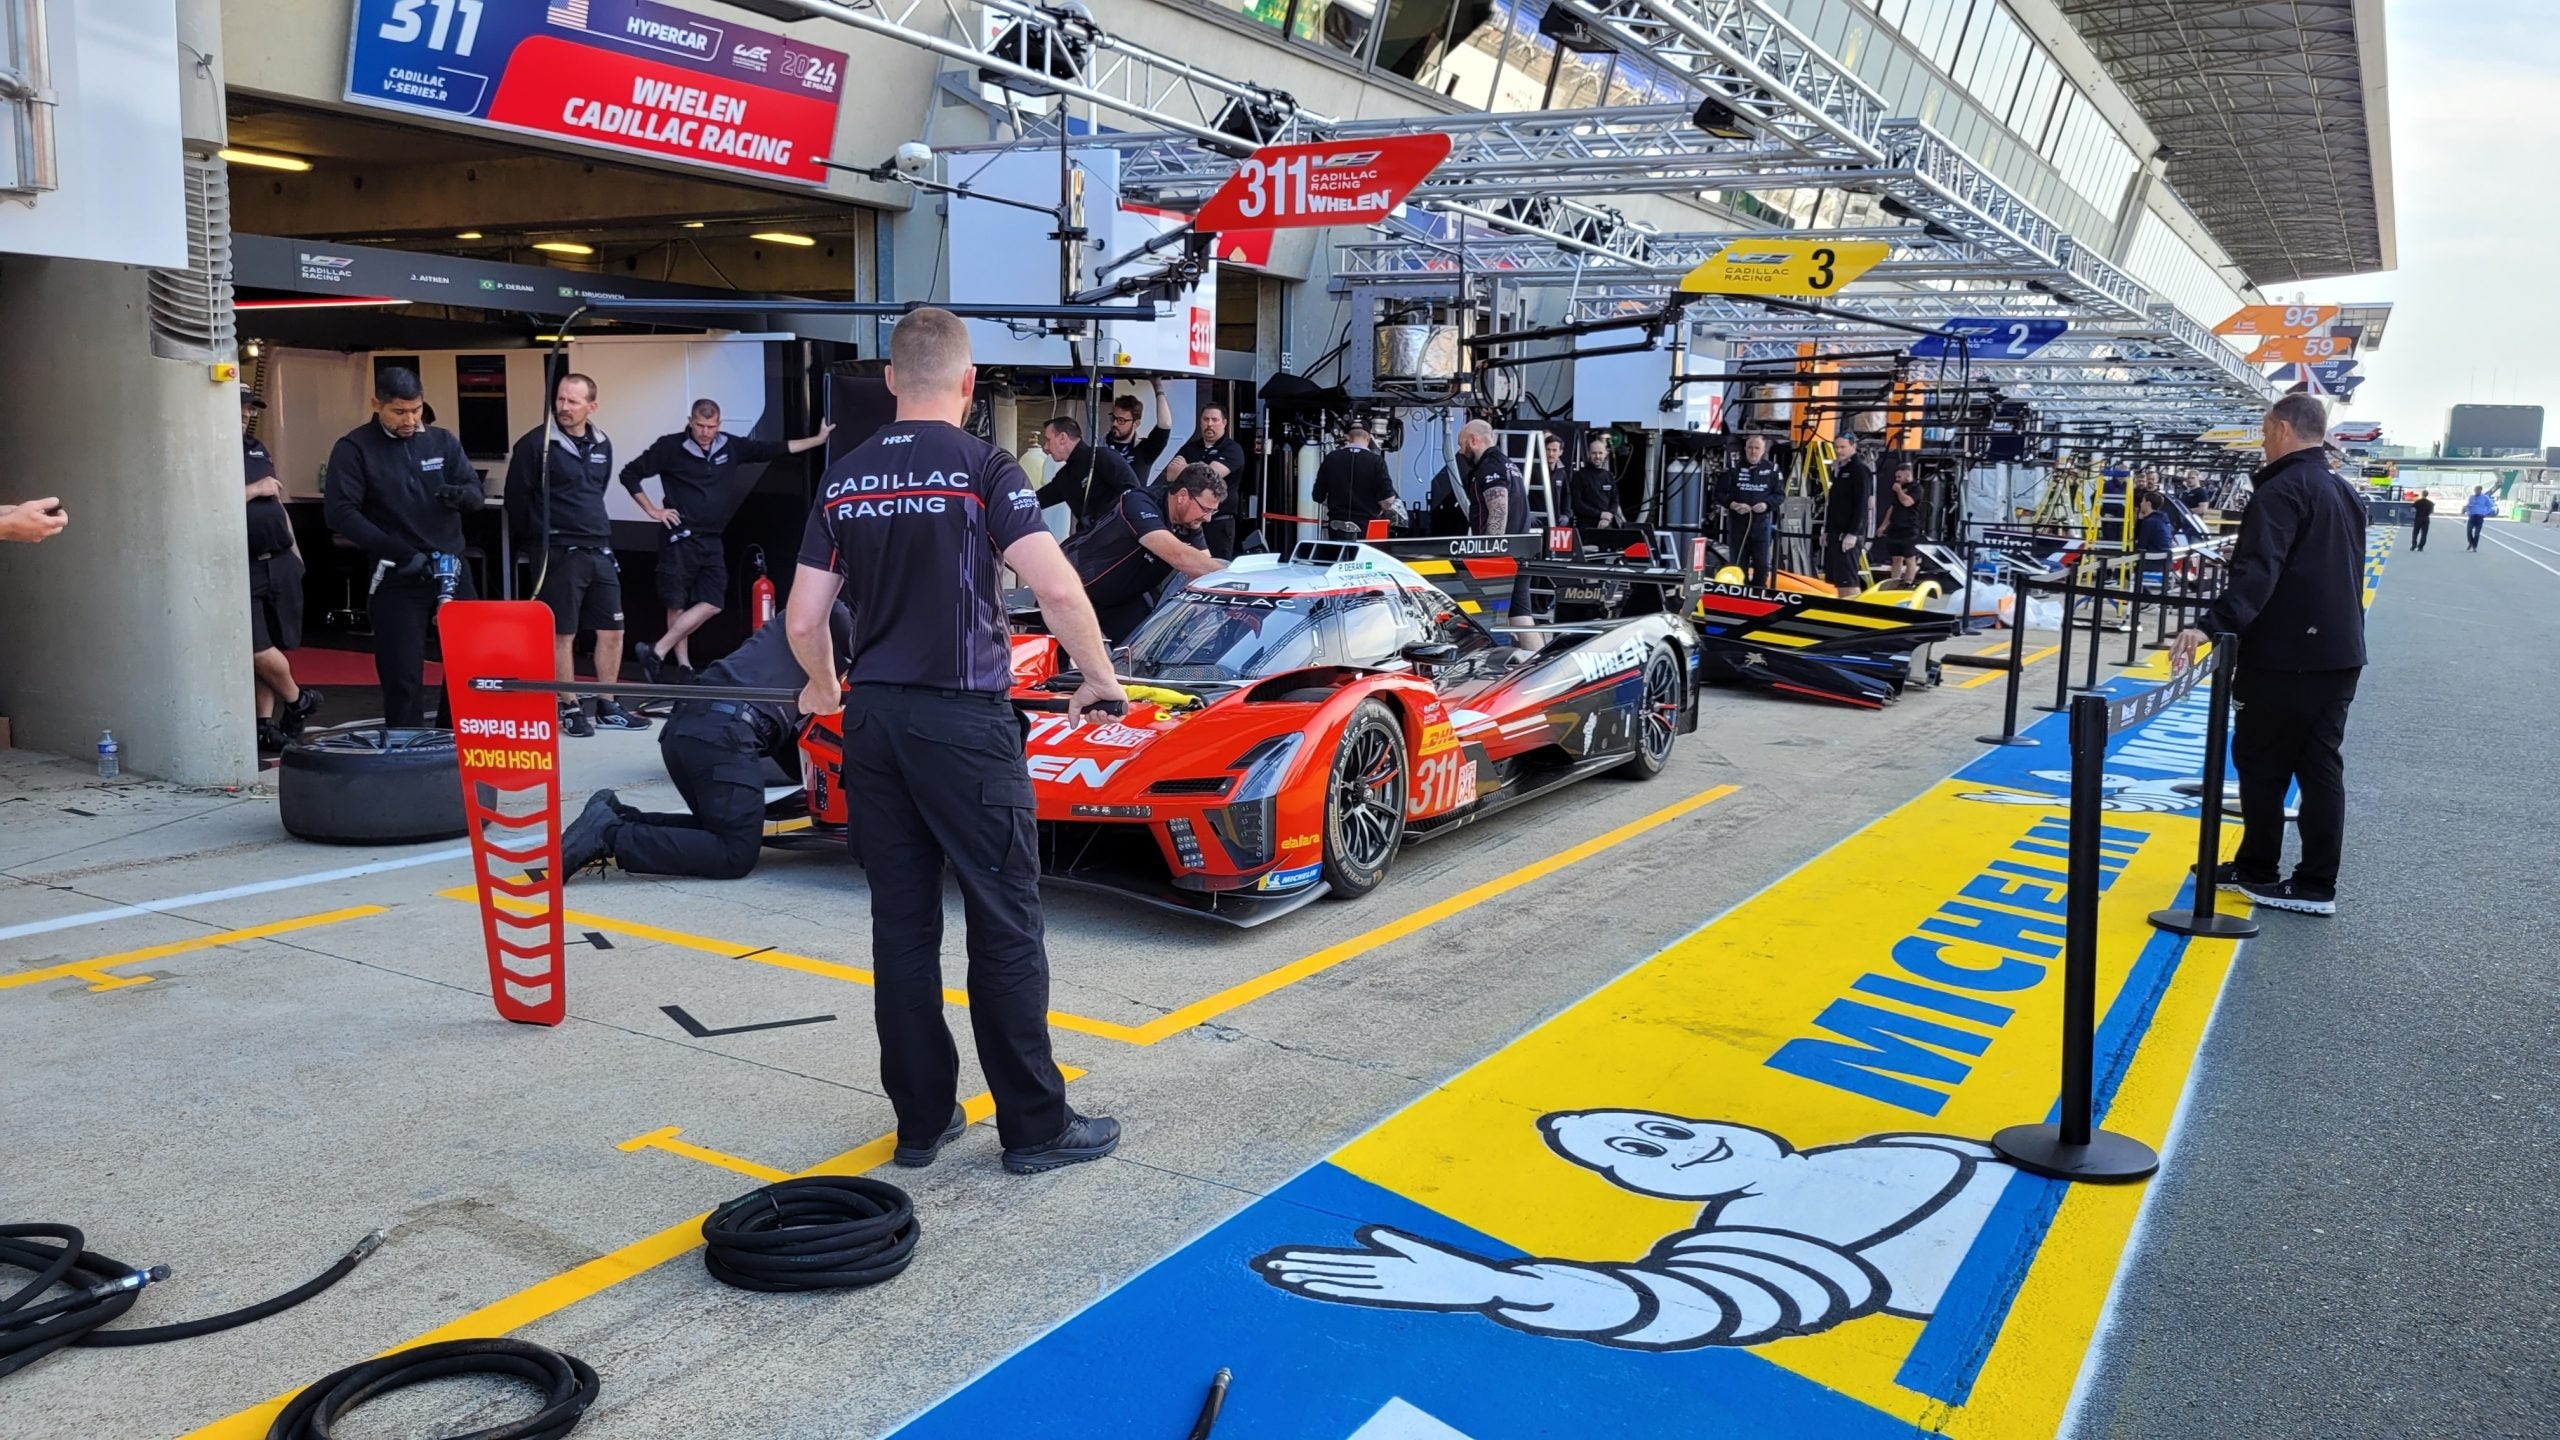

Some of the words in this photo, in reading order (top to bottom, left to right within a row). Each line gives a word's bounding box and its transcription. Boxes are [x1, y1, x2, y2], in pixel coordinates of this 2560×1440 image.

[378, 0, 484, 57] 311
[626, 16, 708, 51] HYPERCAR
[389, 67, 446, 88] CADILLAC
[383, 79, 448, 101] V-SERIES.R
[633, 76, 747, 125] WHELEN
[562, 97, 699, 148] CADILLAC
[698, 124, 793, 166] RACING
[1238, 155, 1307, 217] 311
[1311, 170, 1378, 183] CADILLAC
[1311, 180, 1361, 191] RACING
[1307, 189, 1390, 213] WHELEN
[302, 265, 353, 278] CADILLAC
[302, 272, 341, 282] RACING
[1724, 274, 1773, 282] RACING
[1725, 267, 1789, 276] CADILLAC
[1808, 248, 1836, 290] 3
[2283, 306, 2320, 328] 95
[1191, 321, 1209, 354] 311
[2006, 323, 2030, 354] 2
[2303, 338, 2334, 356] 59
[881, 434, 915, 446] HRX
[826, 470, 970, 499] CADILLAC
[838, 497, 946, 520] RACING
[1450, 538, 1509, 555] CADILLAC
[1549, 529, 1572, 549] HY
[1565, 588, 1601, 599] Mobil
[1701, 580, 1803, 605] CADILLAC
[1570, 629, 1649, 682] WHELEN
[460, 718, 517, 738] Brakes
[463, 748, 506, 768] BACK
[508, 750, 553, 770] PUSH
[1410, 750, 1458, 815] 311
[1280, 869, 1318, 884] MICHELIN
[1763, 816, 2151, 1117] MICHELIN
